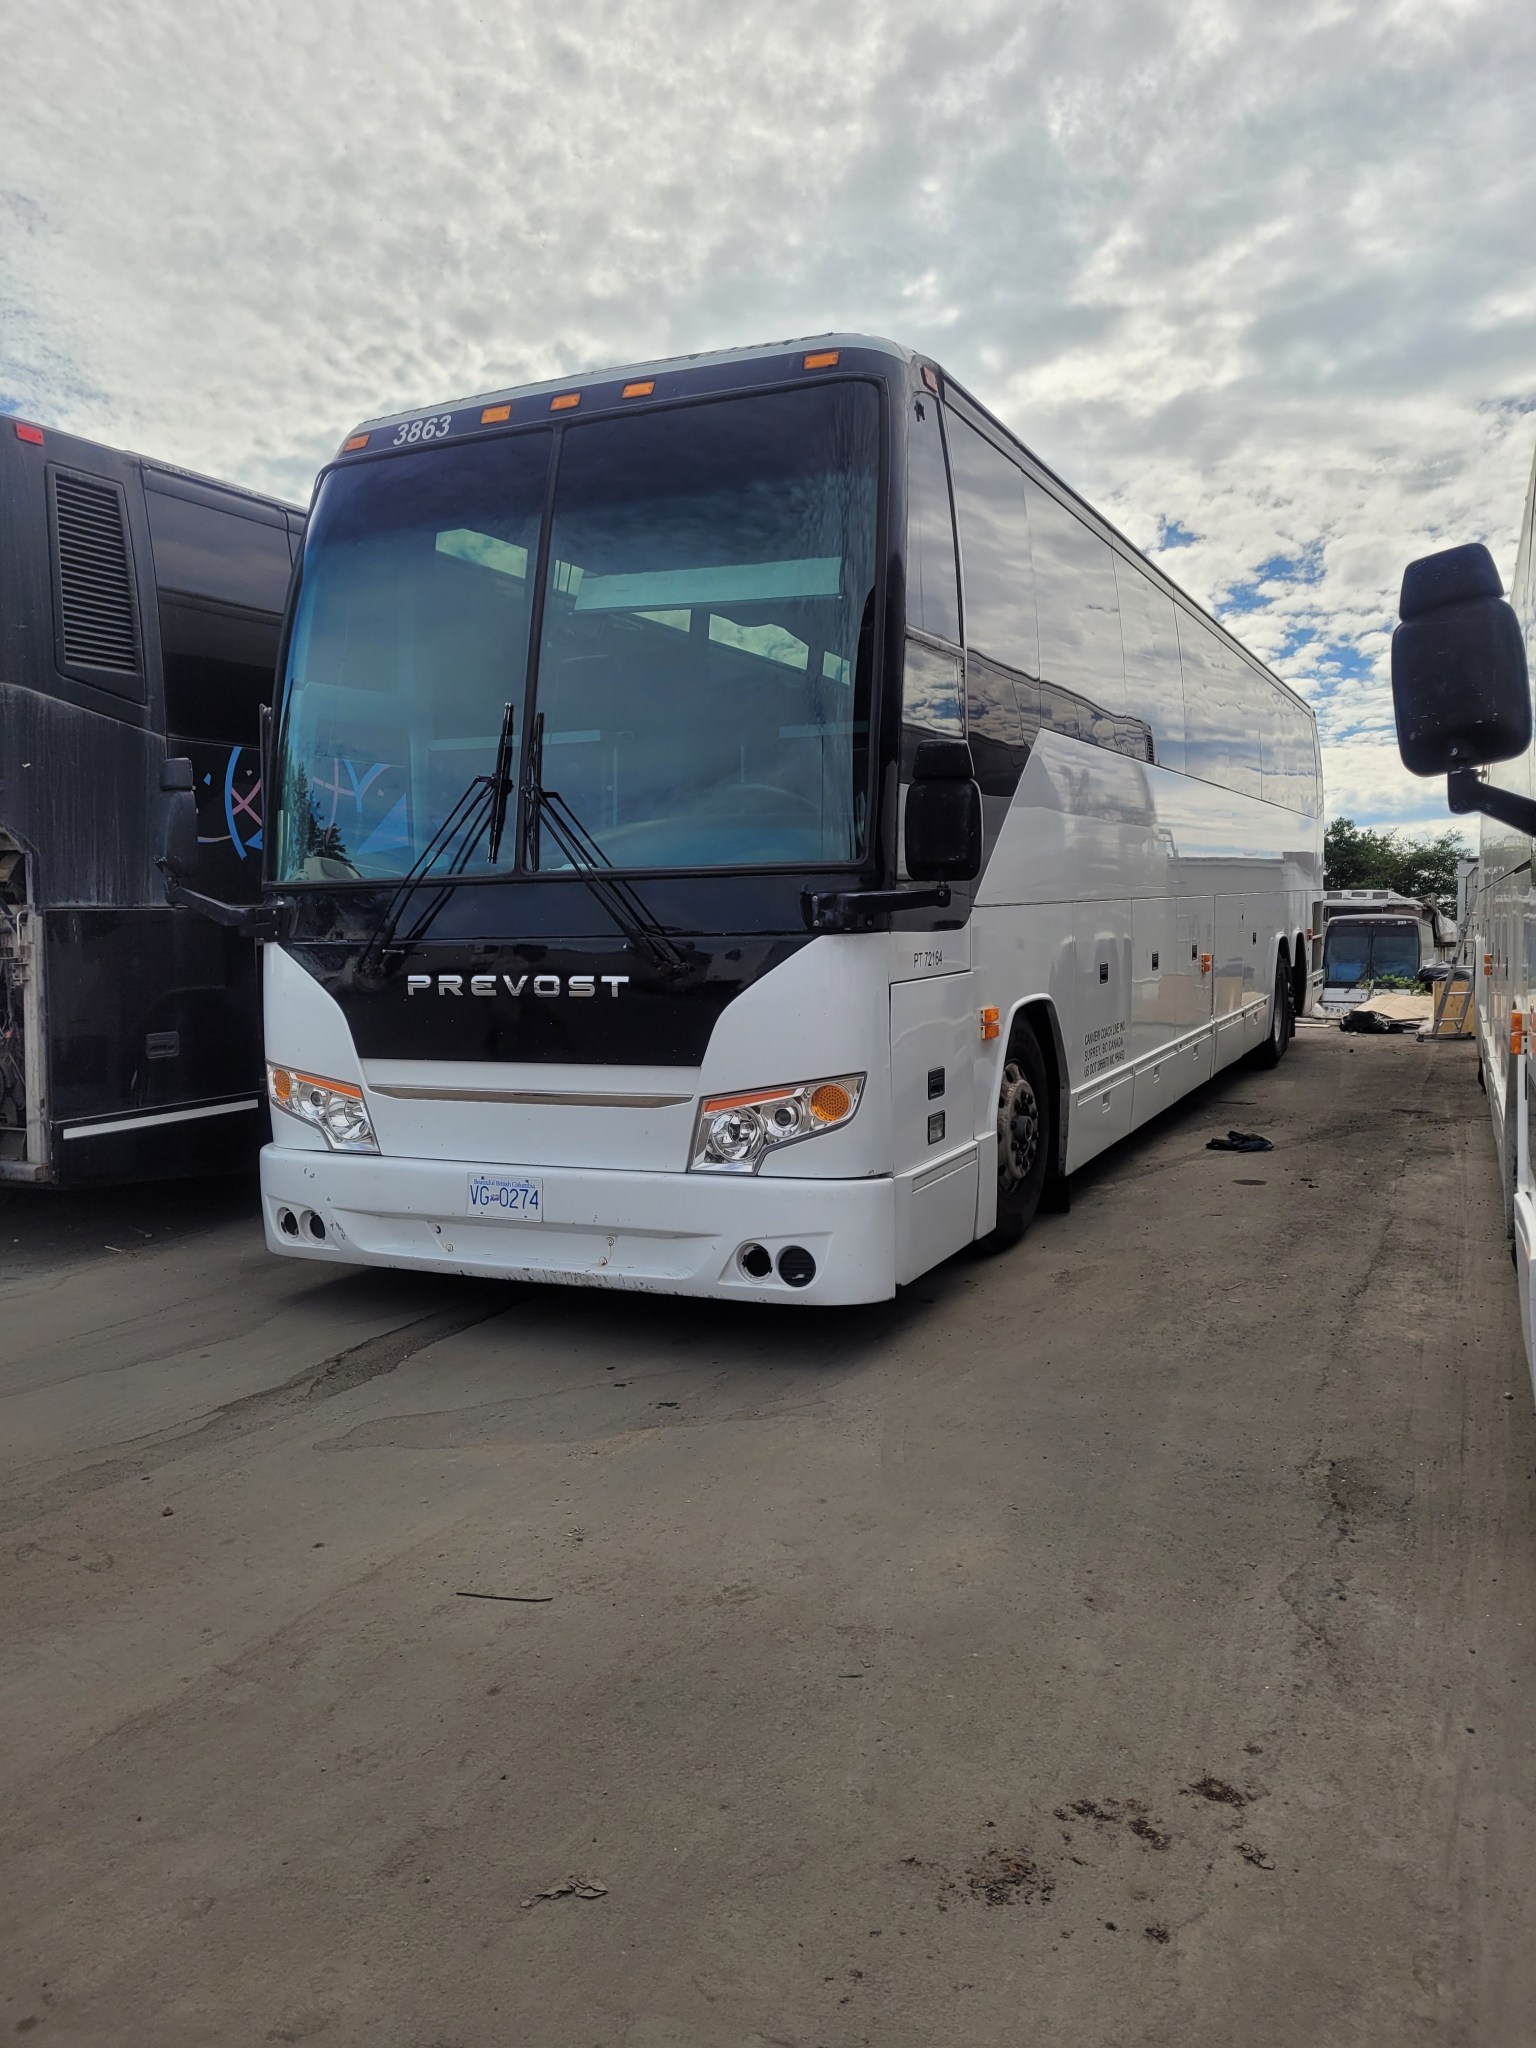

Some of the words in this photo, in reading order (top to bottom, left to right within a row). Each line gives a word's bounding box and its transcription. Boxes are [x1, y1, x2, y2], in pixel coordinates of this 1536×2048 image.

[393, 415, 452, 445] 3863
[914, 952, 923, 968] PT
[924, 950, 943, 967] 72164
[407, 975, 630, 998] PREVOST
[474, 1178, 495, 1186] Beautiful
[500, 1187, 539, 1210] 0274
